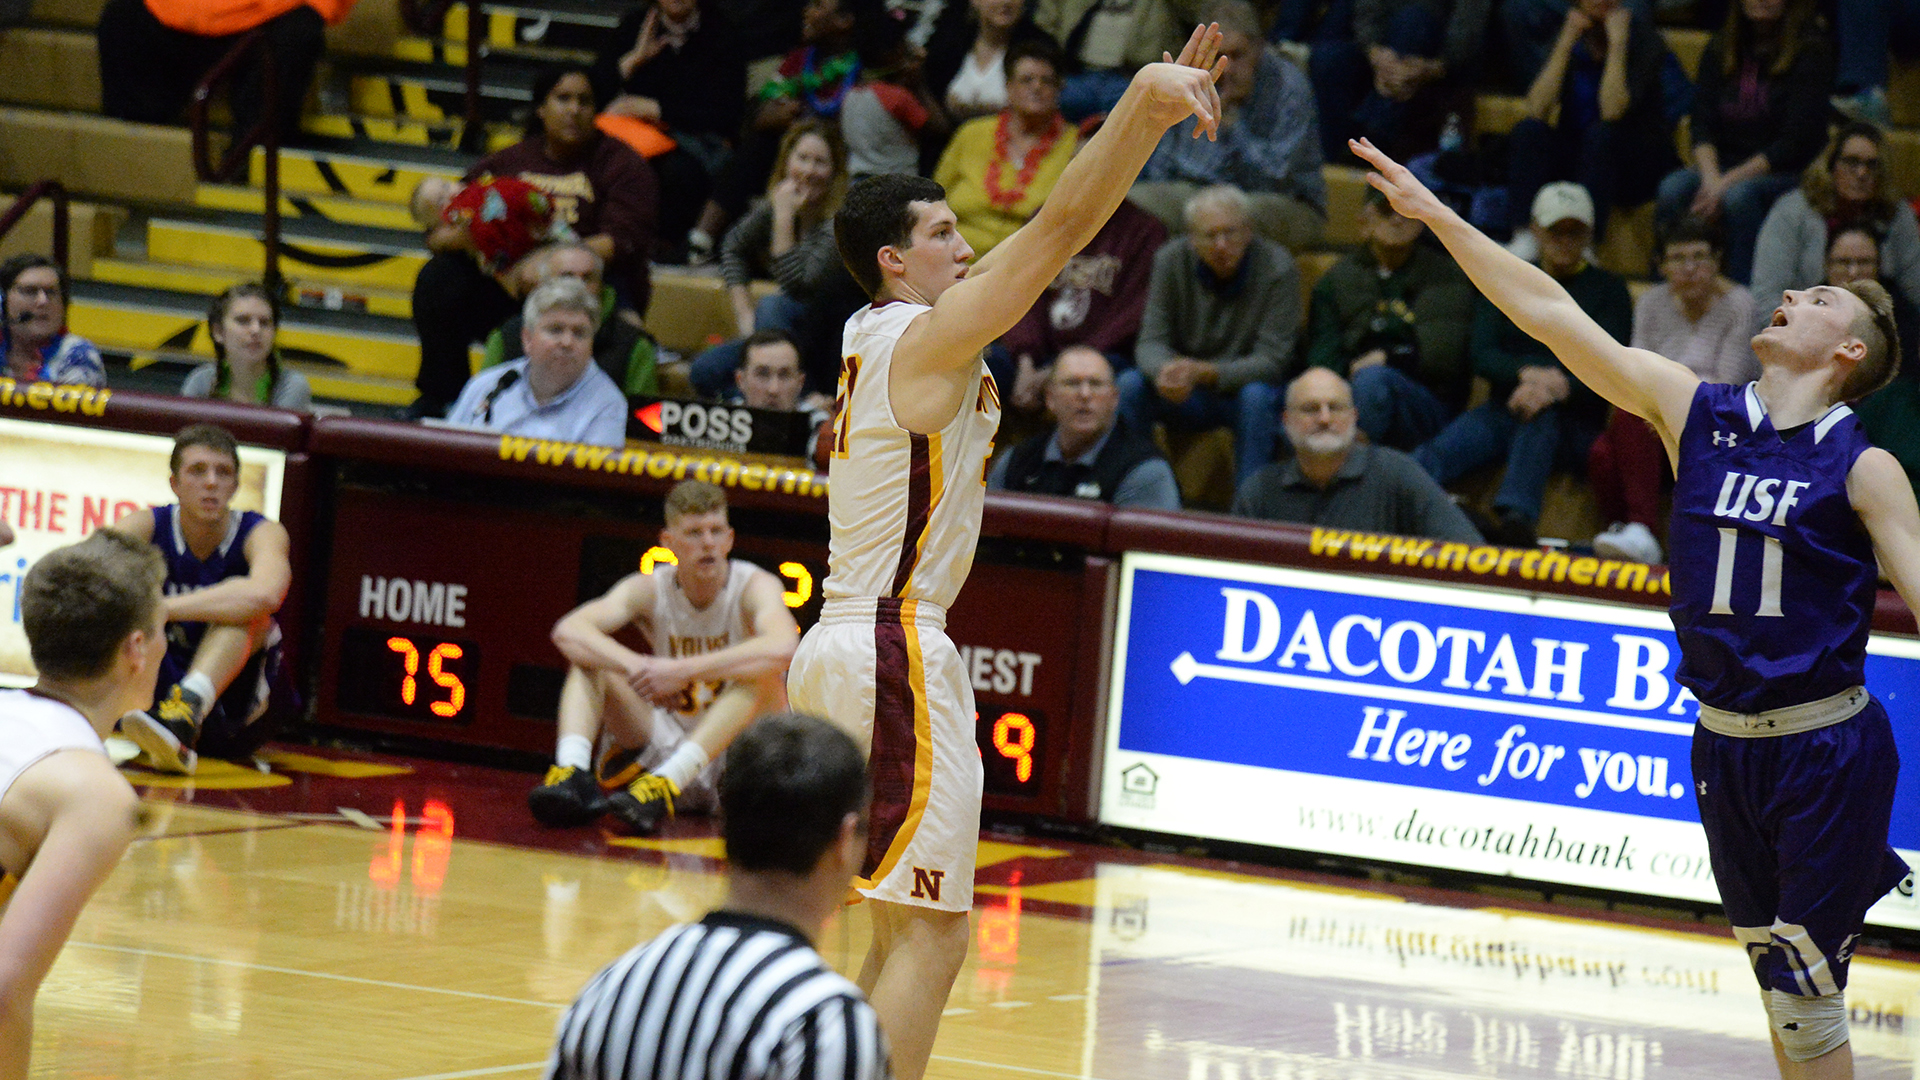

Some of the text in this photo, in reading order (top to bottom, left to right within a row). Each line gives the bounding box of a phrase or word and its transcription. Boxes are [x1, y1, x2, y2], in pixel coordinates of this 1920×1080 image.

[660, 400, 753, 444] POSS
[499, 433, 830, 499] www.northern.
[81, 495, 158, 537] NO
[1712, 471, 1811, 526] USF
[359, 574, 468, 628] HOME
[1708, 527, 1784, 617] 11
[961, 645, 1042, 696] EST
[1216, 587, 1589, 702] DACOTAH
[387, 636, 465, 717] 75
[975, 711, 1036, 783] 9
[1347, 705, 1686, 800] Here for you.
[910, 866, 944, 902] N
